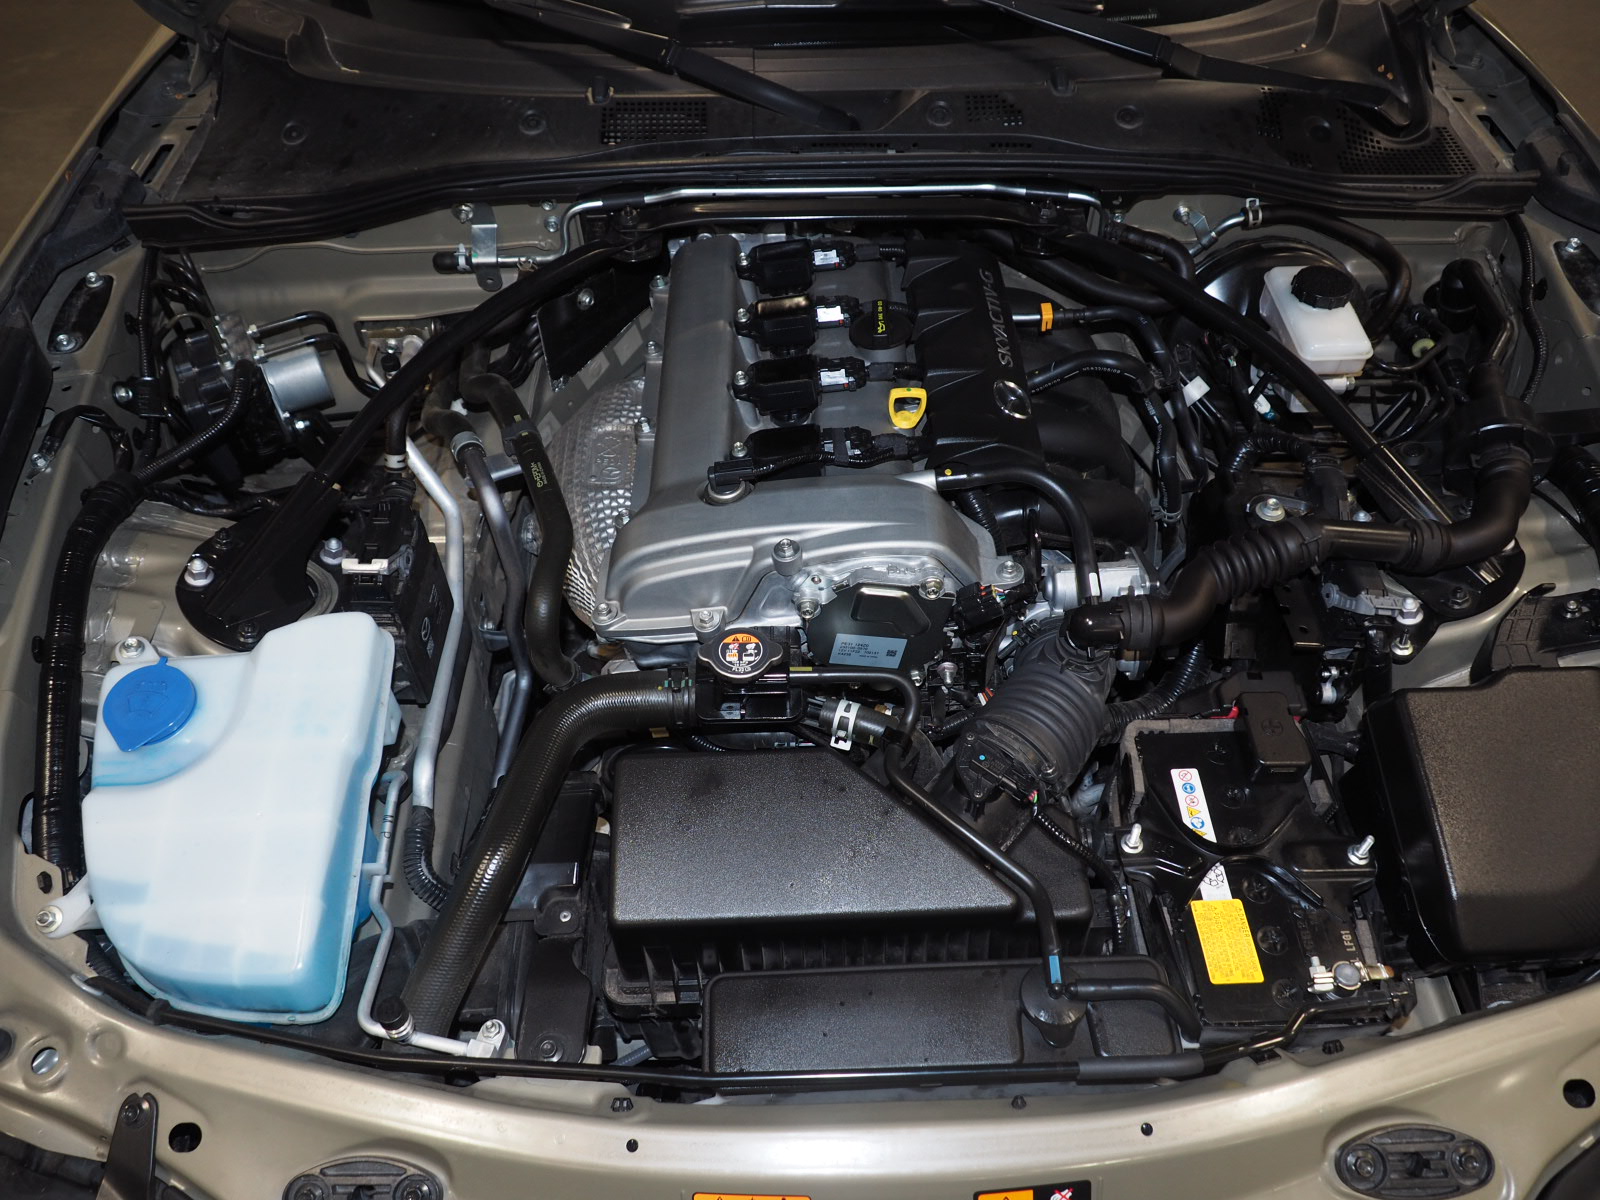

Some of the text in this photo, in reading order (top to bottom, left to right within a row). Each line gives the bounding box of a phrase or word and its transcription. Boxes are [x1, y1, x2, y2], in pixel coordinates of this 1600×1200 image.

[979, 268, 1014, 368] SKYACTIV-G
[1213, 912, 1224, 933] POISON
[1237, 913, 1251, 938] DANGER
